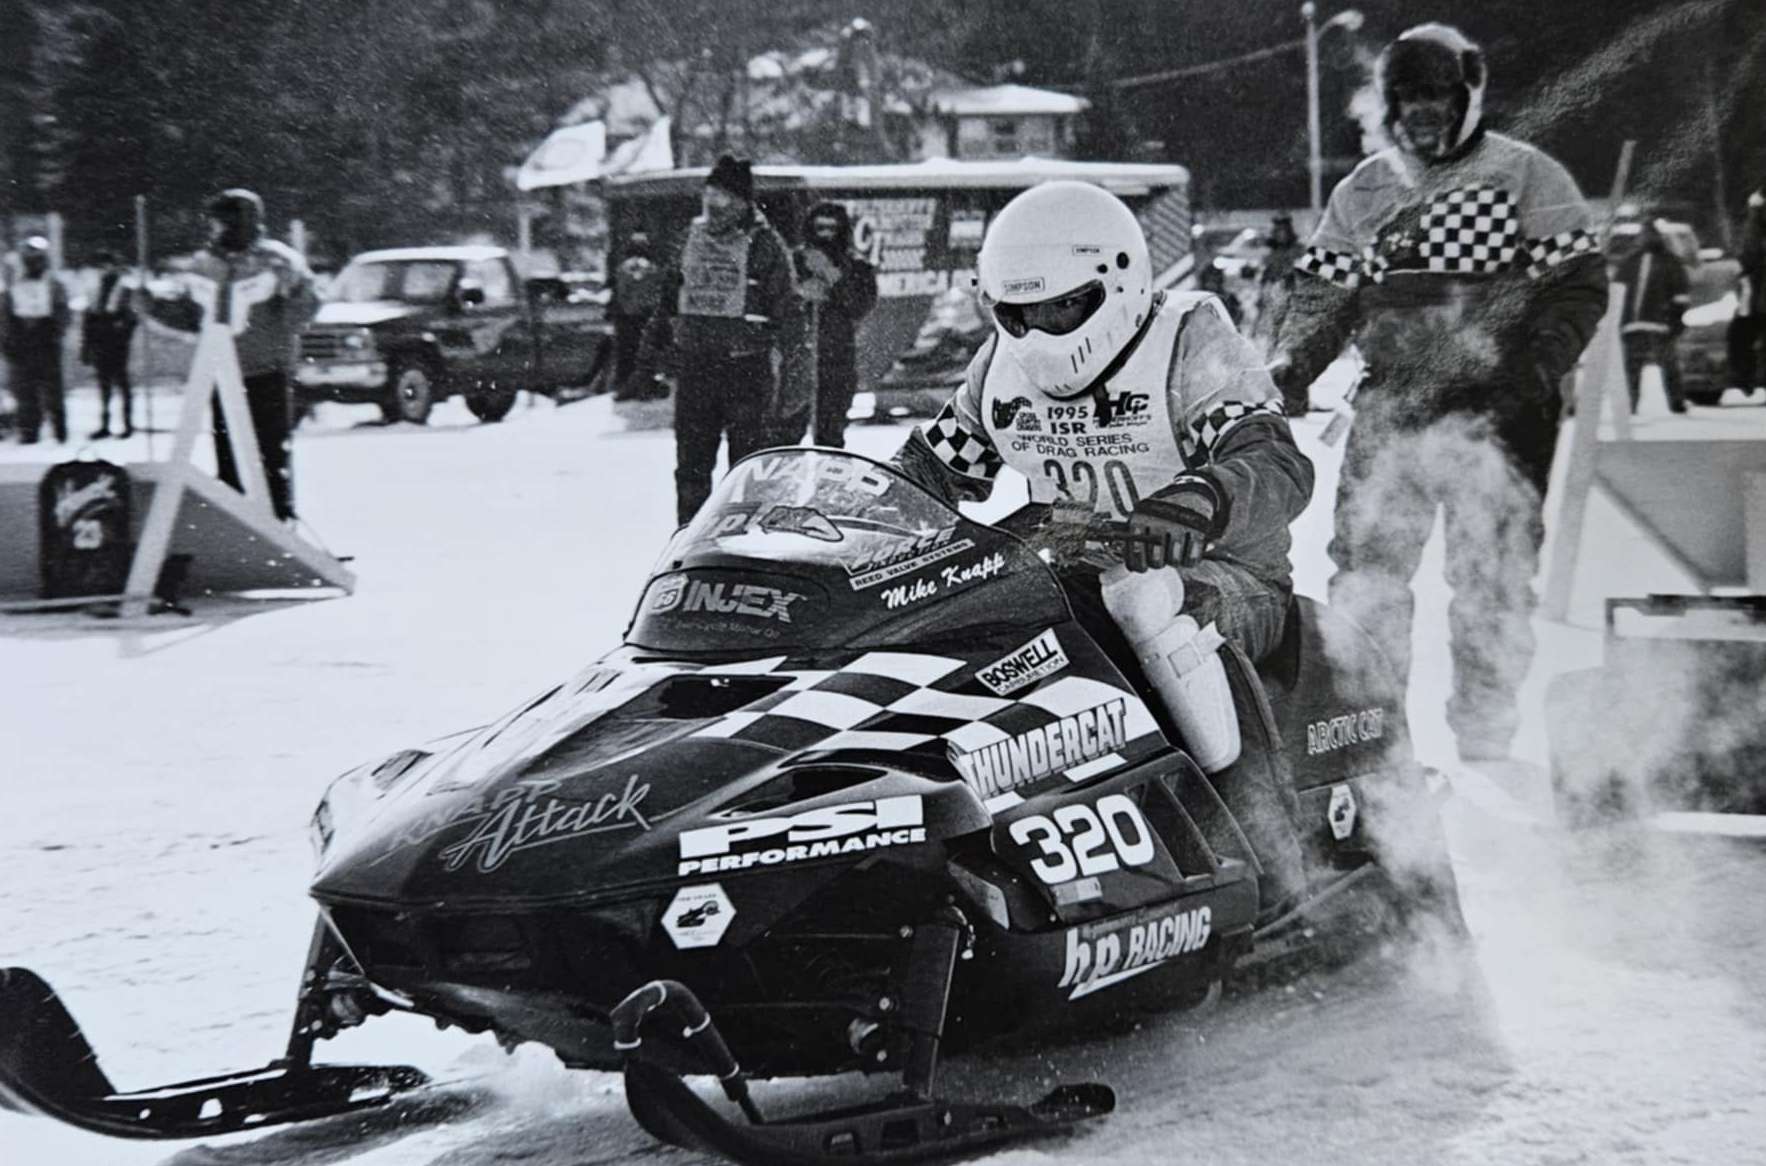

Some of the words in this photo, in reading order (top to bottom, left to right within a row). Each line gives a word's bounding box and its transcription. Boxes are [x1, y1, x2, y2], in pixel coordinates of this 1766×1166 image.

[1004, 279, 1041, 293] SIMPSON
[1047, 406, 1089, 420] 1995
[1051, 421, 1087, 435] ISR
[1011, 440, 1030, 452] OF
[1037, 445, 1078, 458] DRAG
[1085, 441, 1150, 457] RACING
[1017, 433, 1068, 447] WORLD
[1076, 432, 1133, 448] SERIES
[854, 573, 884, 588] REED
[886, 560, 918, 577] VALVE
[880, 578, 938, 610] Mike
[940, 551, 1006, 588] Knapp
[682, 579, 808, 624] INJEX
[981, 638, 1059, 688] BOSWELL
[959, 696, 1127, 800] THUNDERCAT
[1307, 713, 1357, 756] ARCTIC
[1358, 707, 1384, 741] CAT
[438, 774, 651, 874] Attack
[678, 794, 925, 859] PSI
[1008, 793, 1155, 885] 320
[677, 827, 927, 877] PERFORMANCE
[1057, 927, 1121, 988] hp
[1122, 905, 1213, 970] RACING
